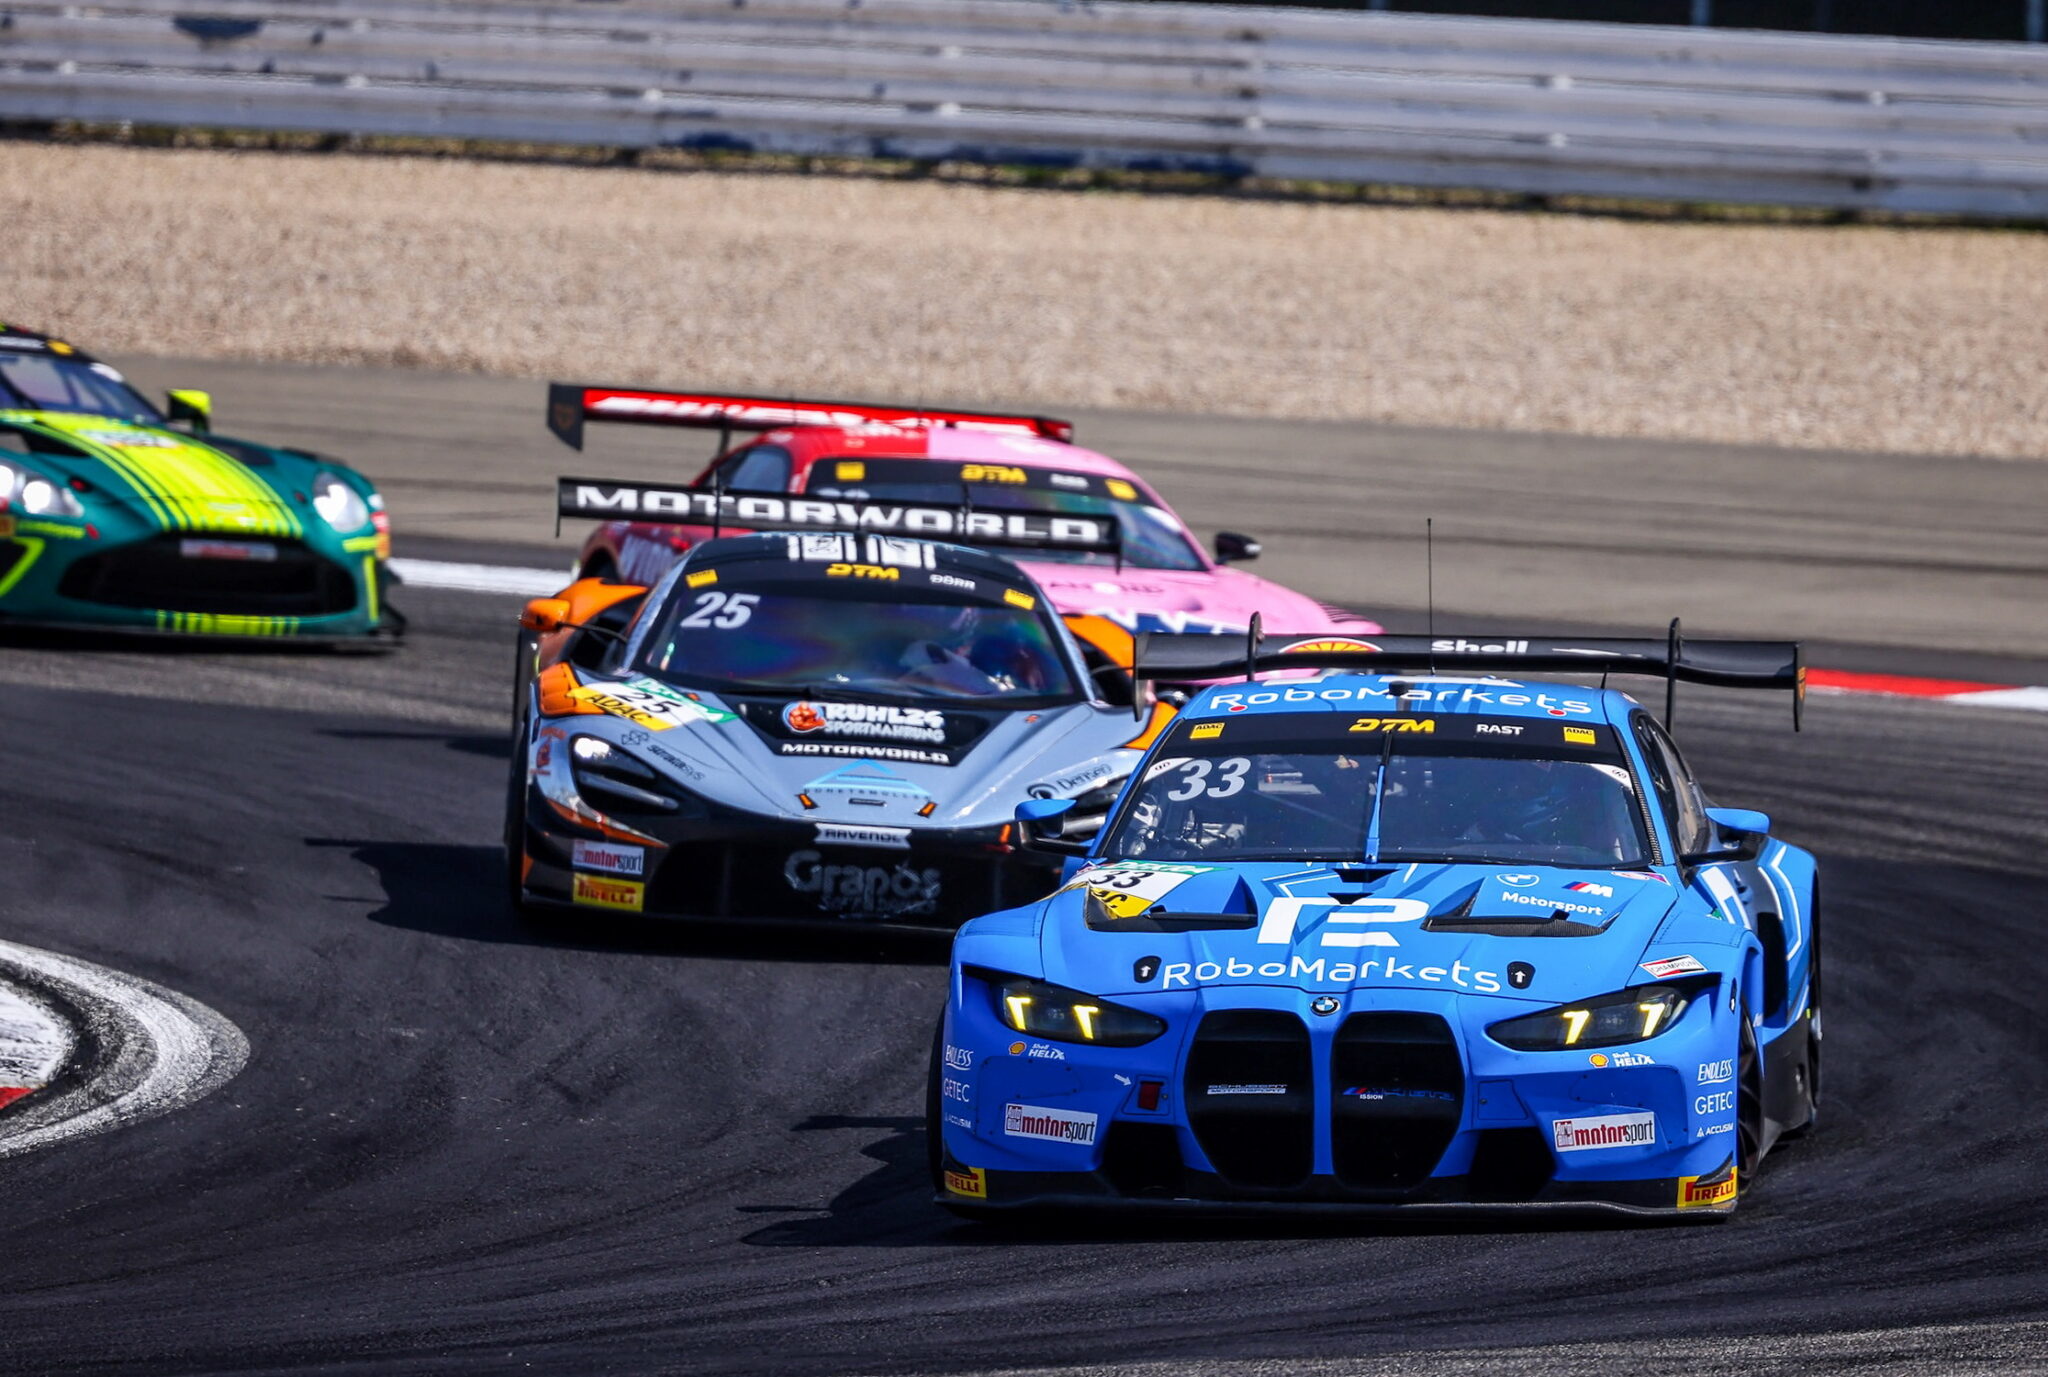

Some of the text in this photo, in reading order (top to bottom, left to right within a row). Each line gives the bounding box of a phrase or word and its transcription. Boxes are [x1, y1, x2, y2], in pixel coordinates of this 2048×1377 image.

[960, 464, 1028, 485] DTM
[576, 486, 1100, 541] MOTORWORLD
[826, 562, 899, 581] DTM
[680, 591, 761, 629] 25
[1431, 640, 1528, 654] Shell
[585, 693, 653, 722] ADAC
[614, 691, 682, 714] 25
[1210, 681, 1593, 714] RoboMarkets
[1349, 718, 1435, 733] DTM
[1476, 723, 1524, 736] RAST
[1566, 727, 1593, 737] ADAC
[782, 743, 949, 764] MOTORWORLD
[1167, 757, 1251, 802] 33
[1088, 870, 1155, 889] 33
[1502, 891, 1604, 916] Motorsport
[1162, 956, 1501, 993] RoboMarkets
[1650, 960, 1700, 974] CHAMPION
[1028, 1049, 1065, 1060] HELIX
[1614, 1054, 1655, 1067] HELIX
[1697, 1059, 1733, 1081] ENDLESS
[944, 1078, 970, 1103] GETEC
[1695, 1091, 1734, 1116] GETEC
[1022, 1115, 1095, 1142] motorsport
[1575, 1120, 1654, 1146] motorsport
[1705, 1122, 1734, 1136] ACCUSIM
[1684, 1180, 1734, 1202] PIRELLI
